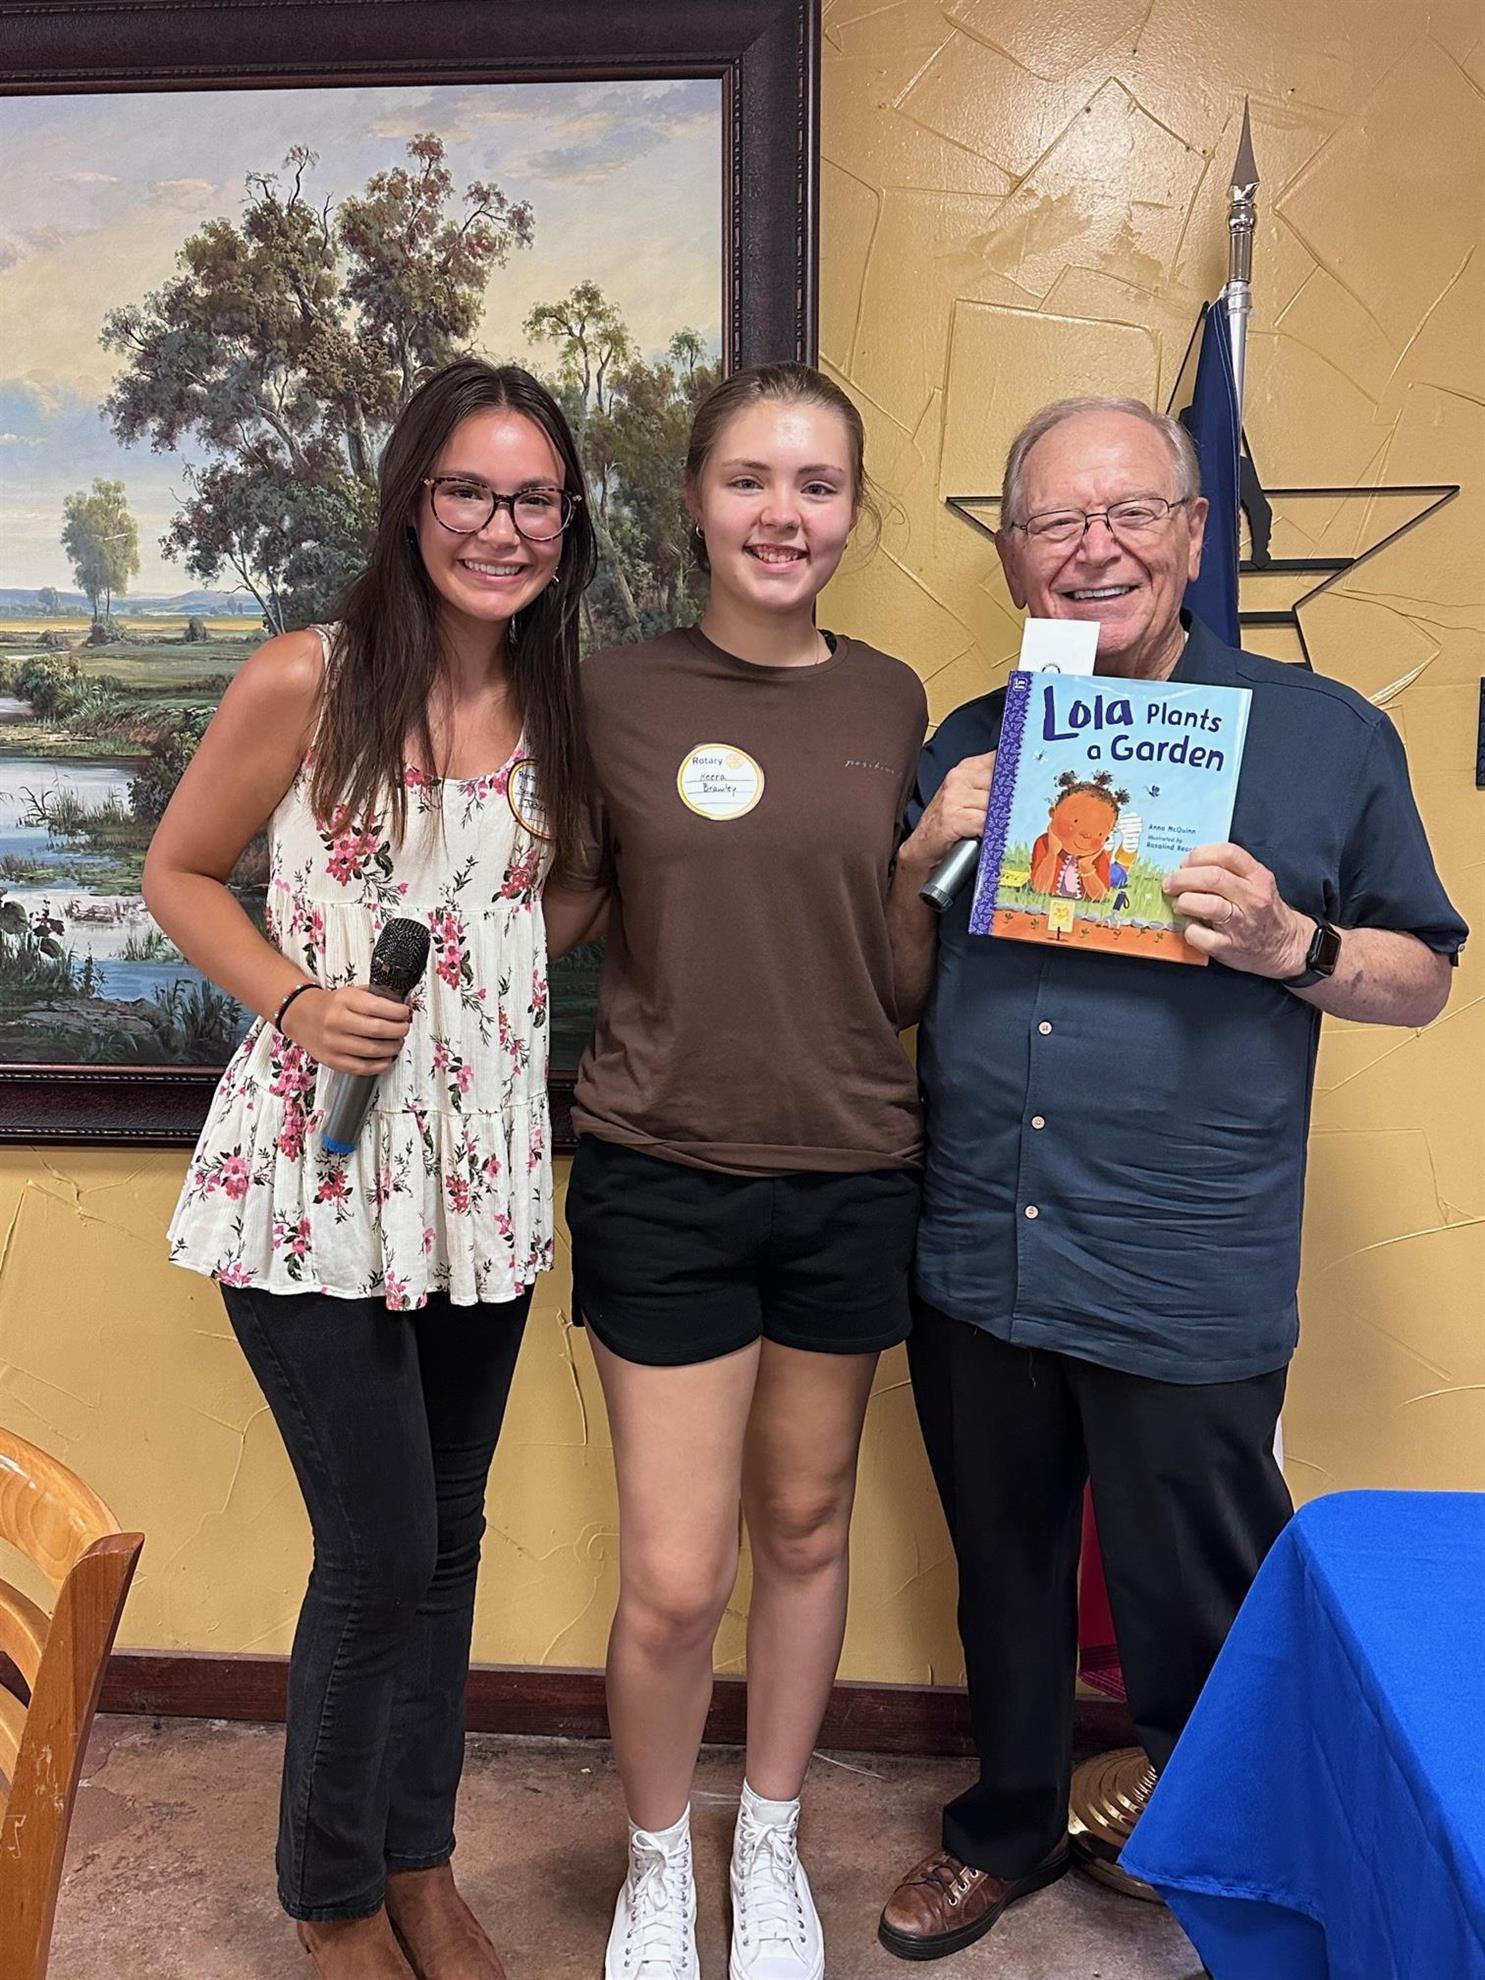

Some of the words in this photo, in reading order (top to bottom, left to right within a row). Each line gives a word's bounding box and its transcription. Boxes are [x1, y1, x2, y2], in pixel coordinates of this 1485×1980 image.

[1043, 685, 1134, 741] Lola
[1147, 702, 1223, 733] Plants
[1087, 744, 1101, 760] a
[1111, 734, 1224, 772] Garden
[692, 756, 724, 765] Rotary
[1148, 823, 1166, 832] Anna
[1167, 825, 1197, 834] McQuinn
[1146, 841, 1175, 851] Rosalind
